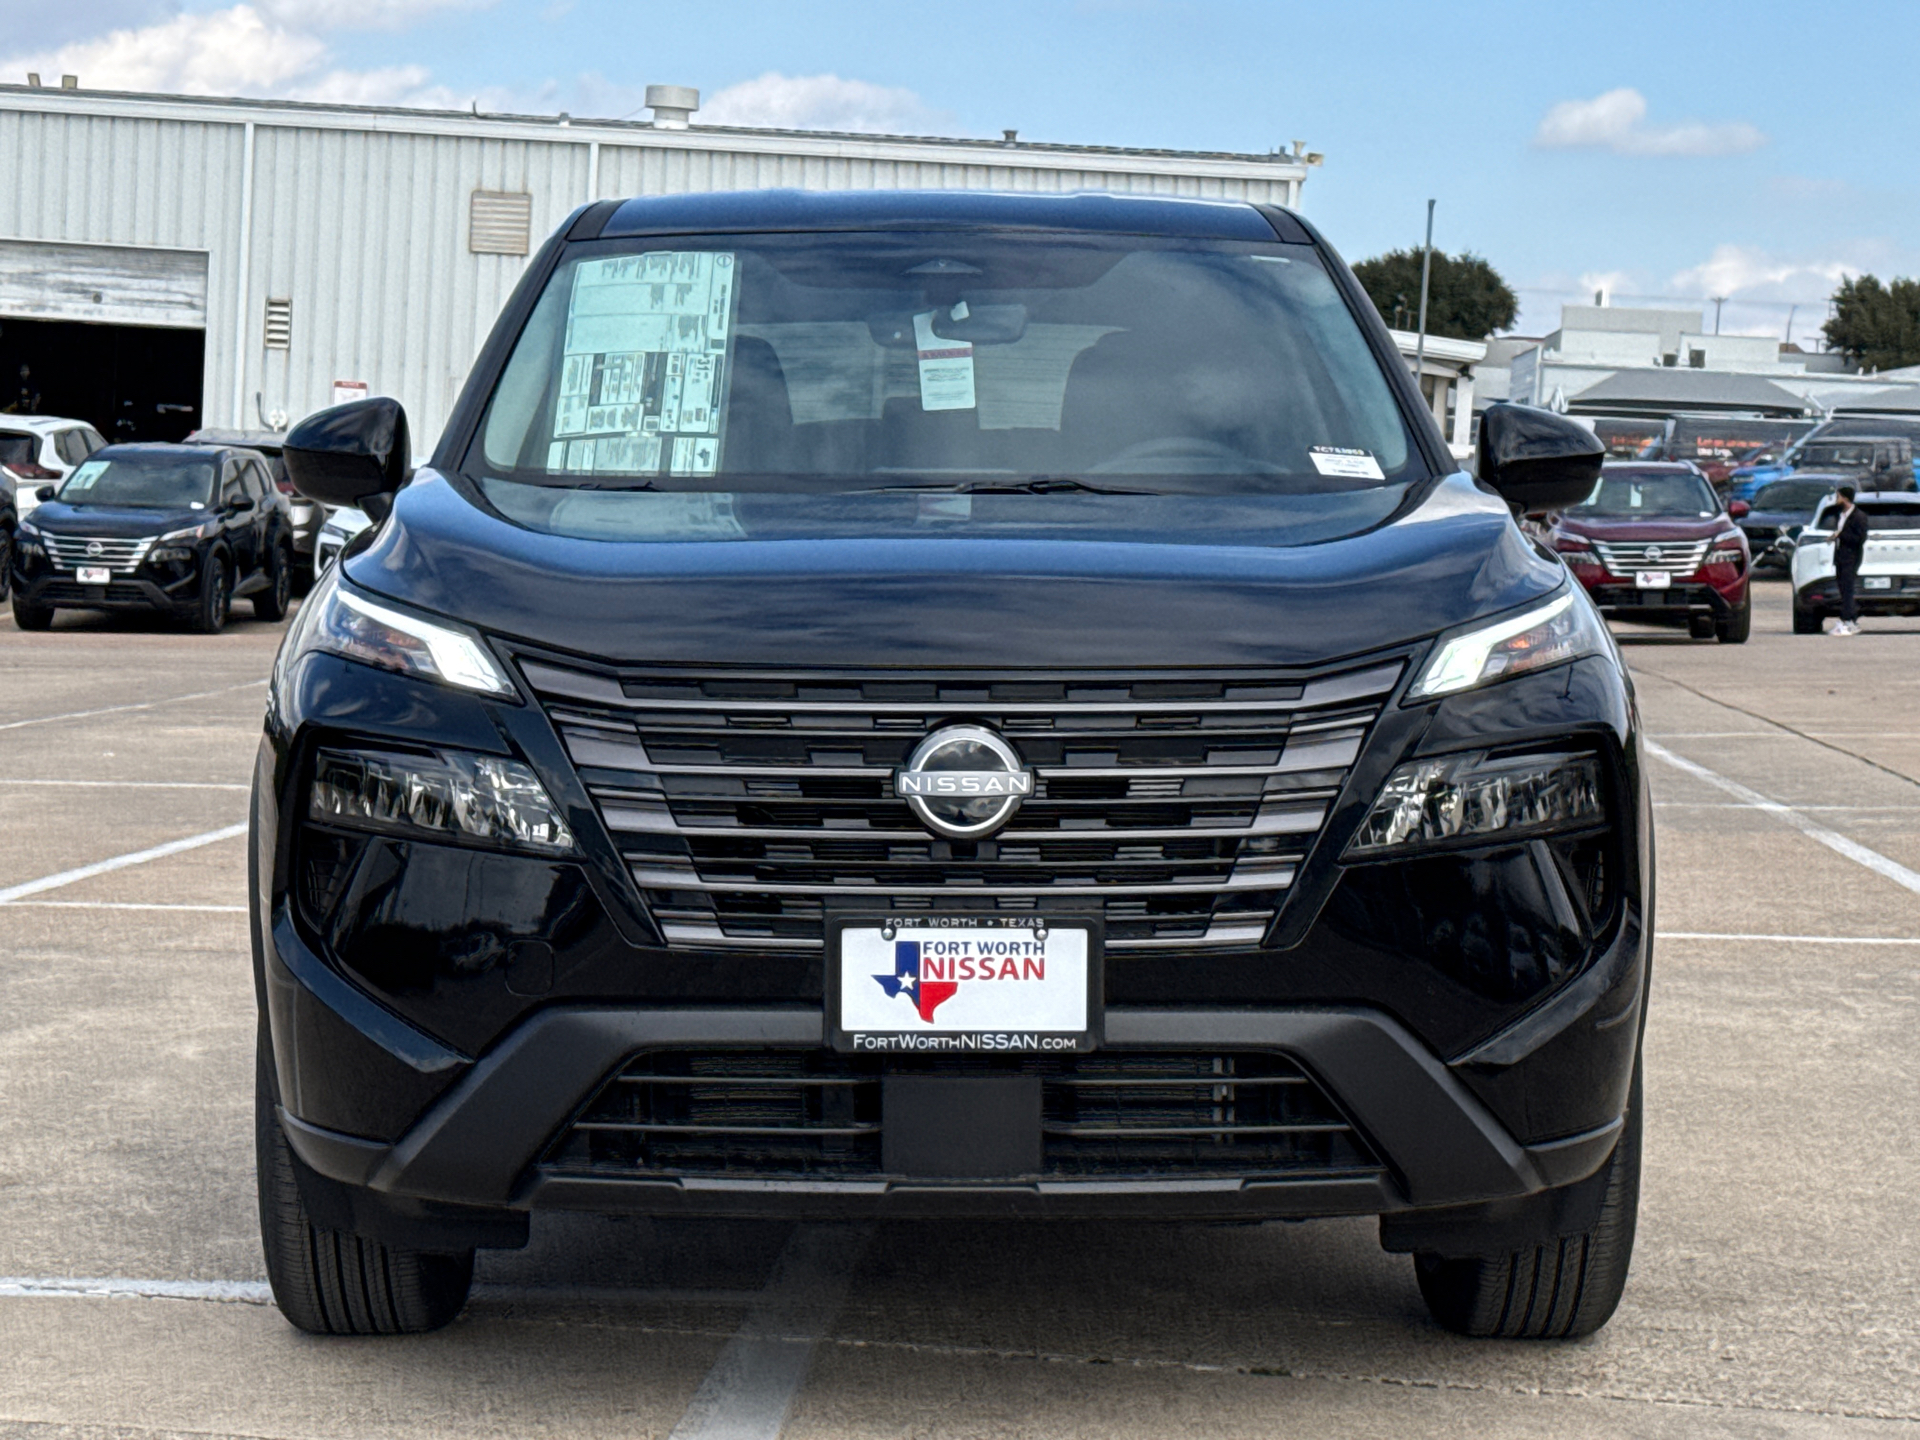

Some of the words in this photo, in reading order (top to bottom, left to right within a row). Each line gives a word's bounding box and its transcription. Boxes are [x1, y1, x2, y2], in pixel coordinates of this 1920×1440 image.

[902, 776, 1027, 792] NISSAN
[885, 918, 921, 928] FORT
[928, 918, 978, 928] WORTH
[1000, 918, 1044, 928] TEXAS
[923, 941, 972, 956] FORT
[978, 941, 1045, 956] WORTH
[923, 957, 1045, 981] NISSAN
